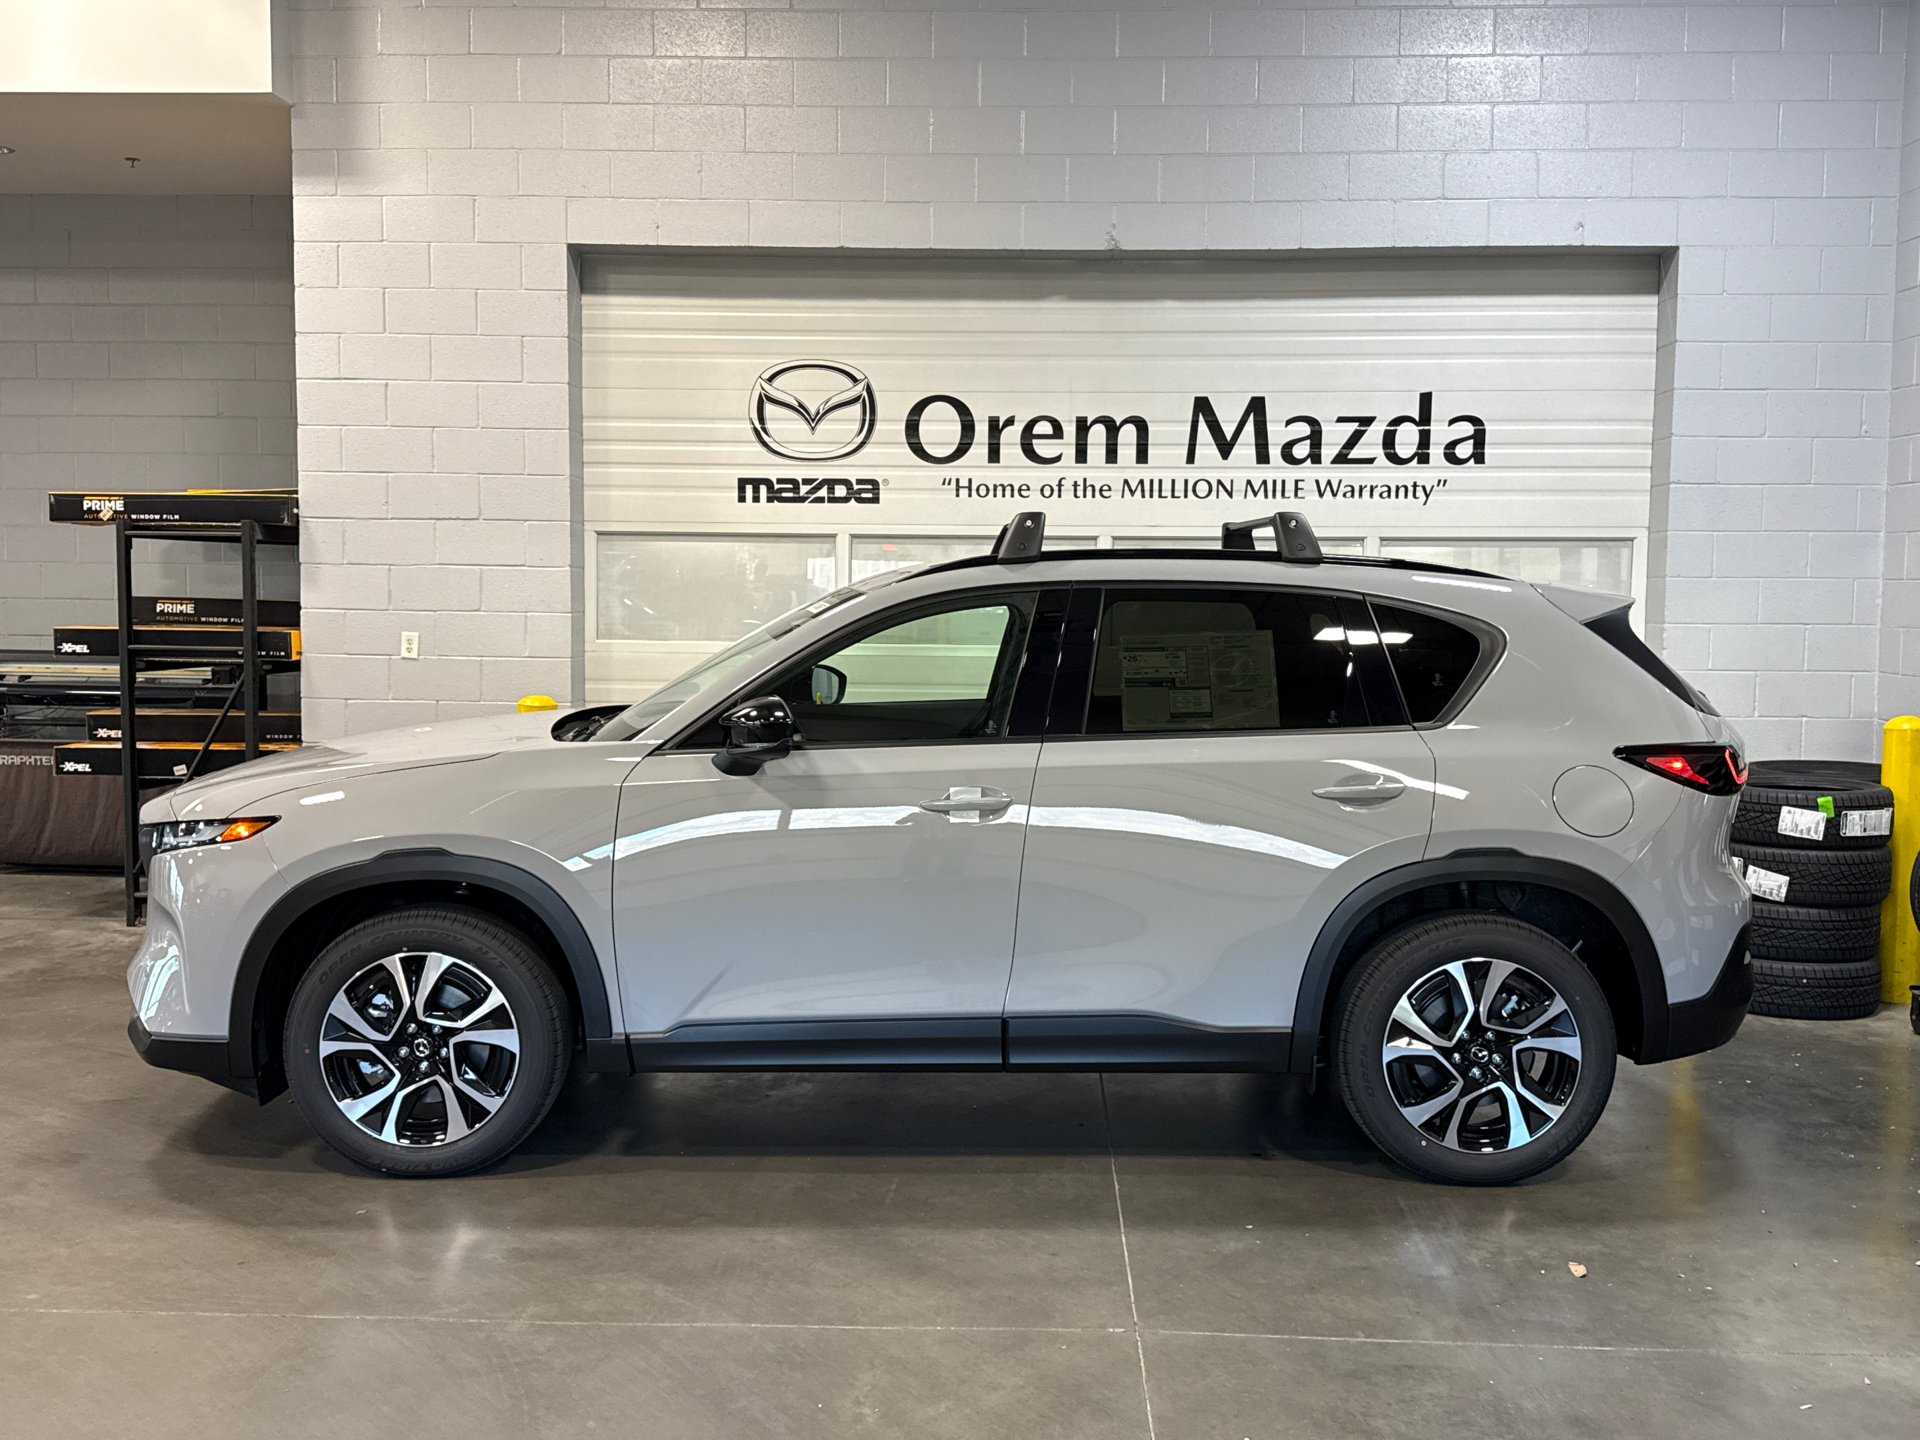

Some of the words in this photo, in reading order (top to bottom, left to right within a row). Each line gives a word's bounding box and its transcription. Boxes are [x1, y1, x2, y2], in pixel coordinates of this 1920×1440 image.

[905, 393, 1150, 465] Orem
[1185, 391, 1487, 466] Mazda
[1039, 477, 1067, 499] of
[1072, 477, 1112, 499] the
[1121, 478, 1235, 499] MILLION
[1243, 479, 1306, 499] MILE
[83, 500, 125, 511] PRIME
[156, 603, 195, 614] PRIME
[57, 643, 90, 653] XPEL
[59, 762, 92, 772] XPEL
[319, 944, 362, 985] OPEN
